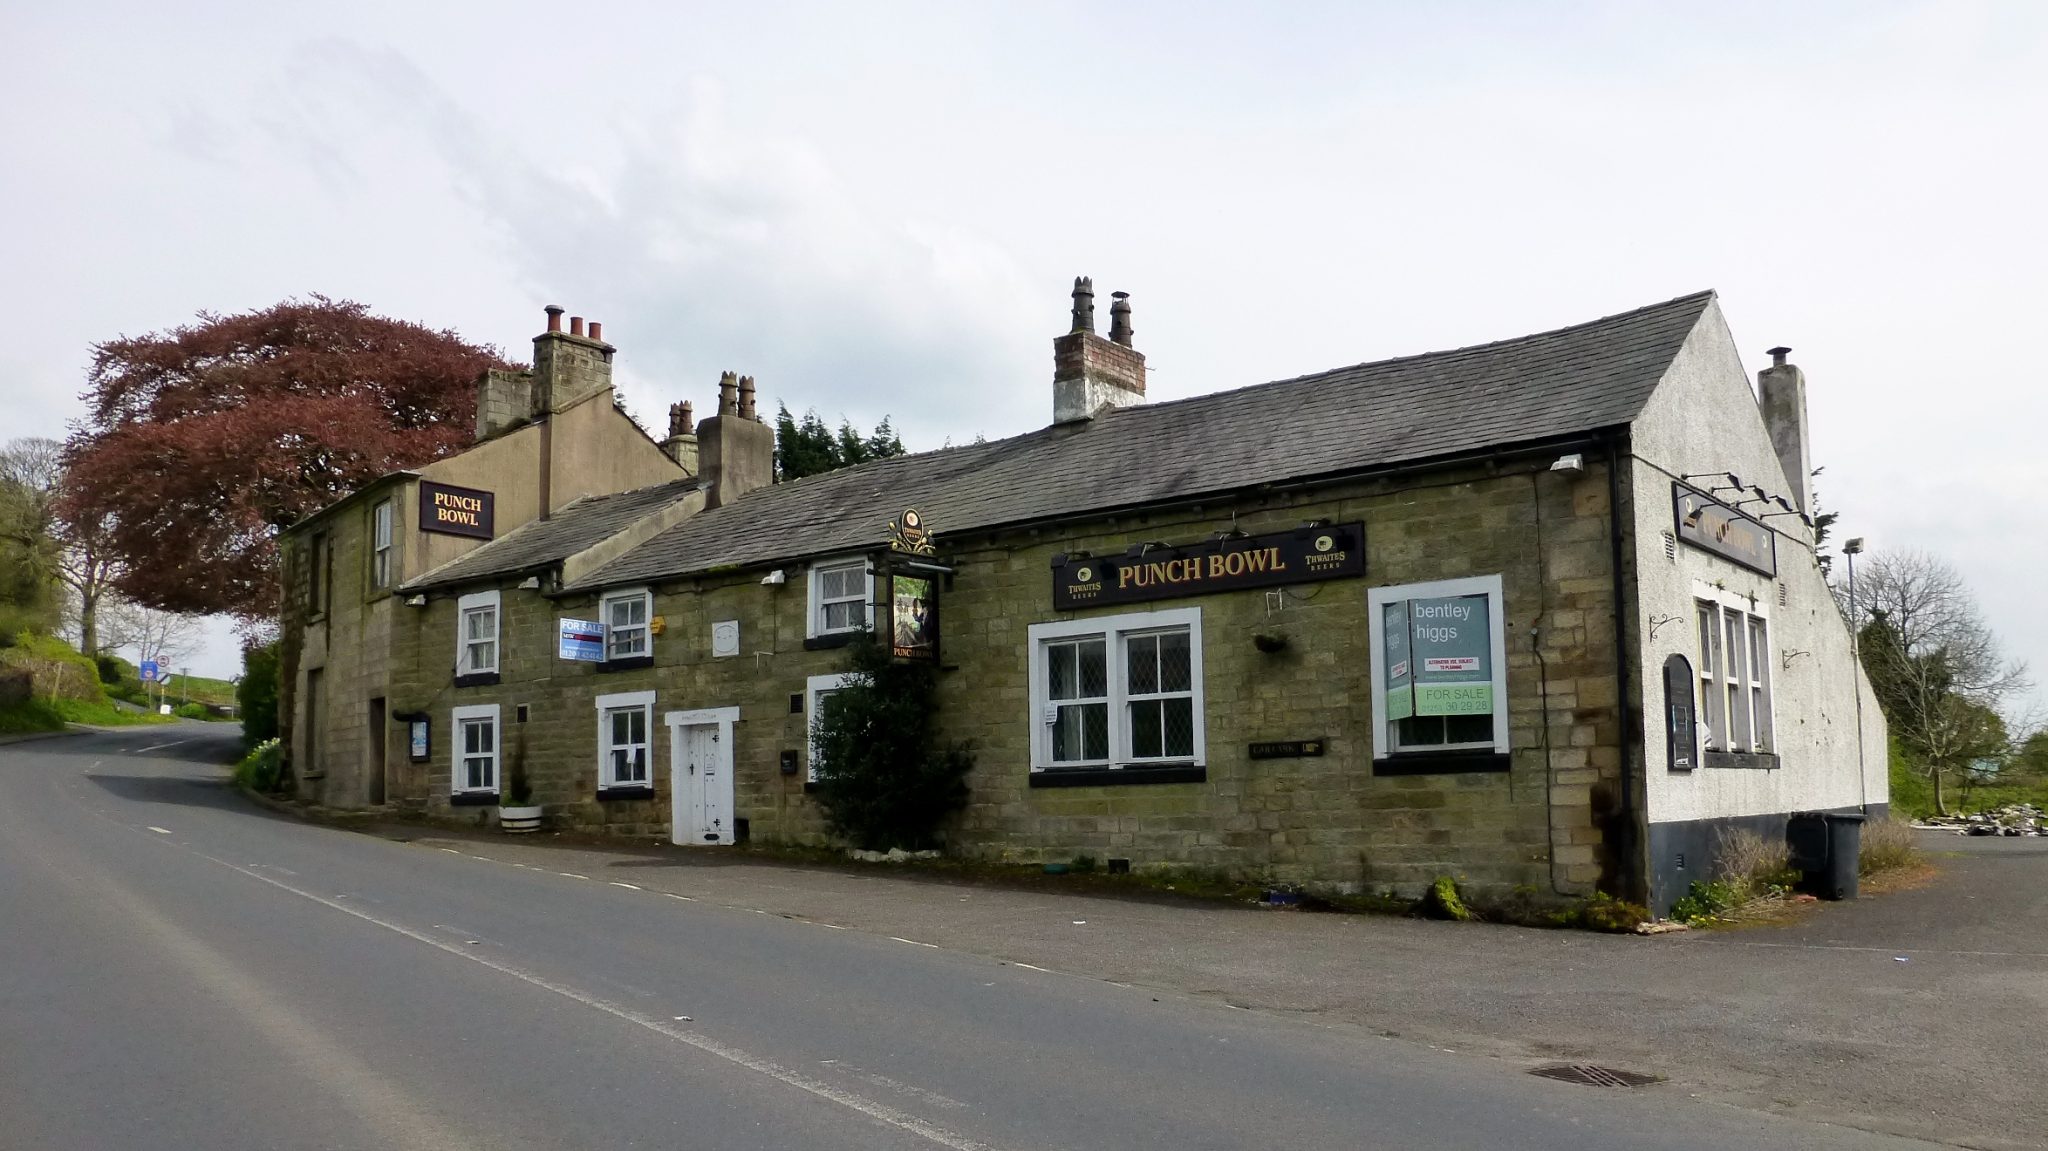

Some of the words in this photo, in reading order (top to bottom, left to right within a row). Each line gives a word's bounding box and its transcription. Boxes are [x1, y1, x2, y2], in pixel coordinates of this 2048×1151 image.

[435, 492, 481, 512] PUNCH
[438, 508, 479, 526] BOWL
[1305, 551, 1345, 565] THWAITES
[1119, 557, 1201, 588] PUNCH
[1209, 547, 1286, 578] BOWL
[1068, 582, 1101, 594] THWAITES
[1416, 603, 1471, 621] bentley
[562, 621, 580, 630] FOR
[581, 623, 603, 633] SALE
[1416, 624, 1457, 643] higgs
[1426, 689, 1450, 700] FOR
[1454, 688, 1484, 699] SALE
[1446, 701, 1458, 711] 30
[1460, 701, 1473, 711] 29
[1475, 700, 1488, 710] 28
